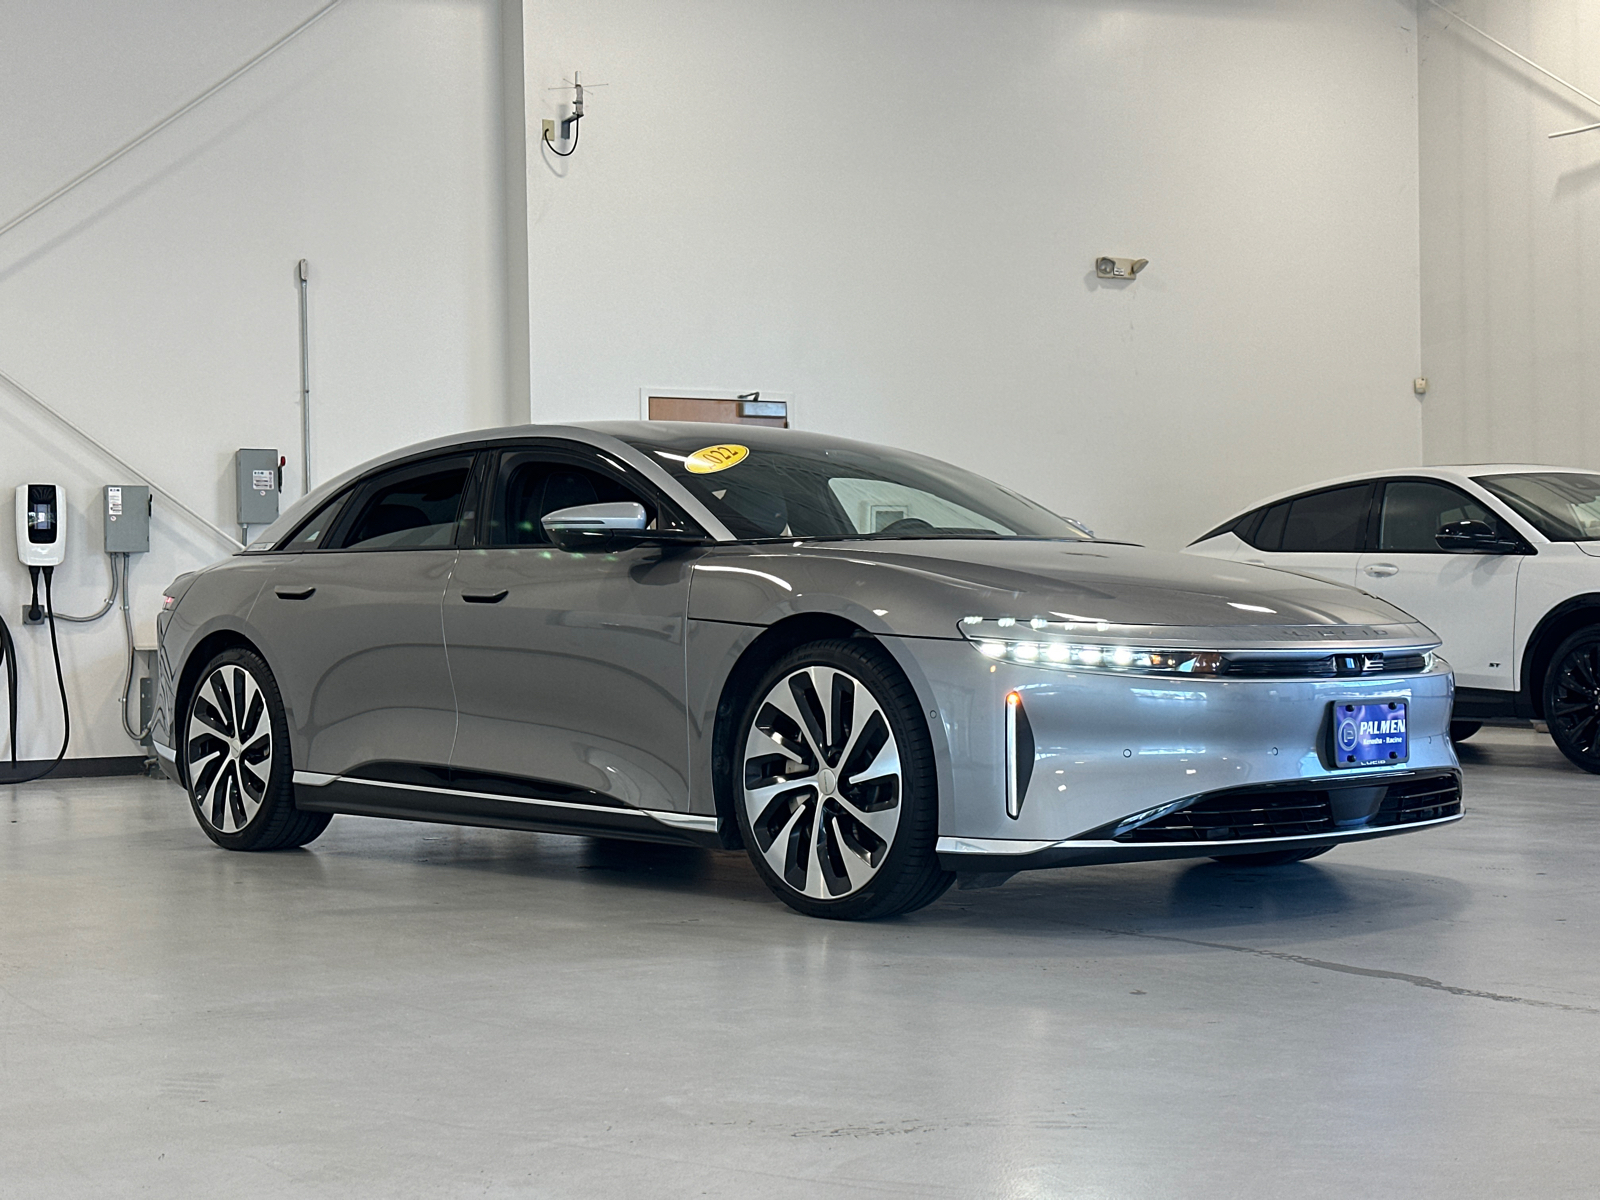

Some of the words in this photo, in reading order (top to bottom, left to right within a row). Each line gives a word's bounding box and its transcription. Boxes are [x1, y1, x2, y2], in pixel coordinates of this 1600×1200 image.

[698, 446, 739, 469] 022
[1360, 719, 1406, 735] PALMEN
[1386, 736, 1403, 744] Racine
